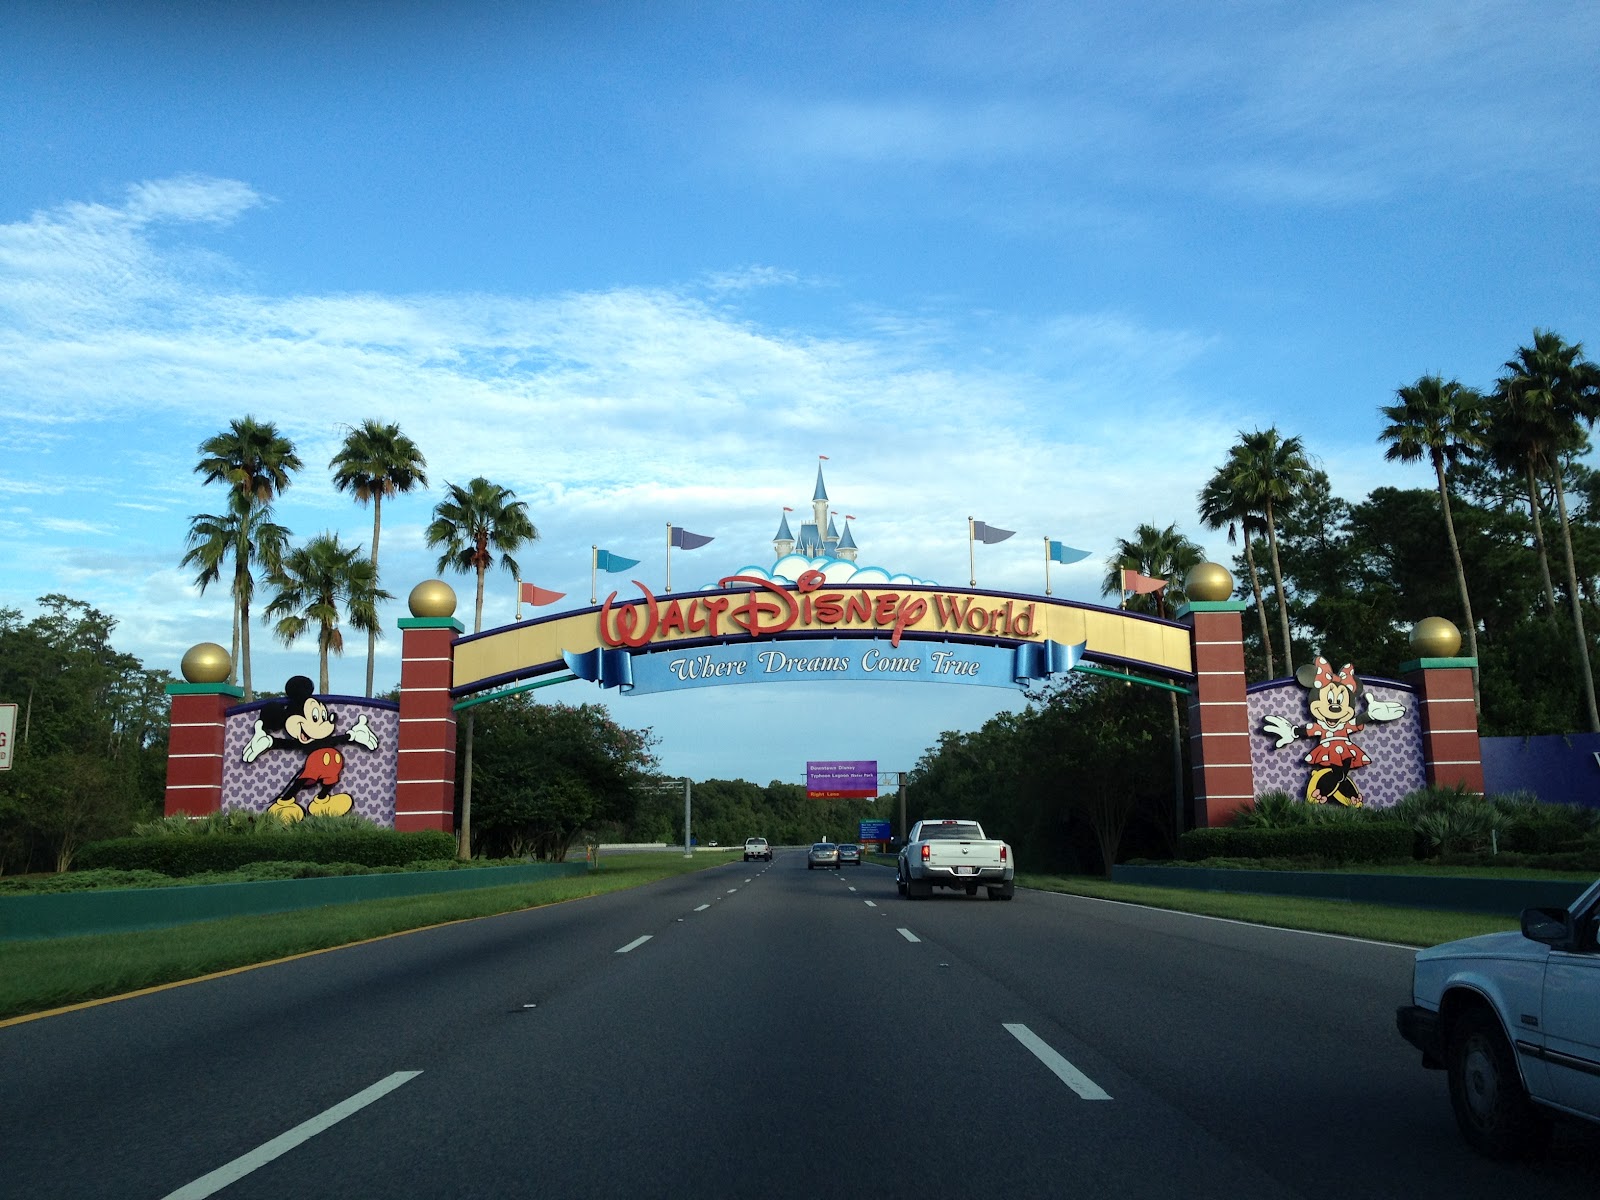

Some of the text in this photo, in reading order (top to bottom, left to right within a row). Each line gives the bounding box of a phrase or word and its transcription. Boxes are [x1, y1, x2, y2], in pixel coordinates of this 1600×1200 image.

[933, 593, 1036, 636] World
[669, 648, 981, 681] Where Dreams Come True
